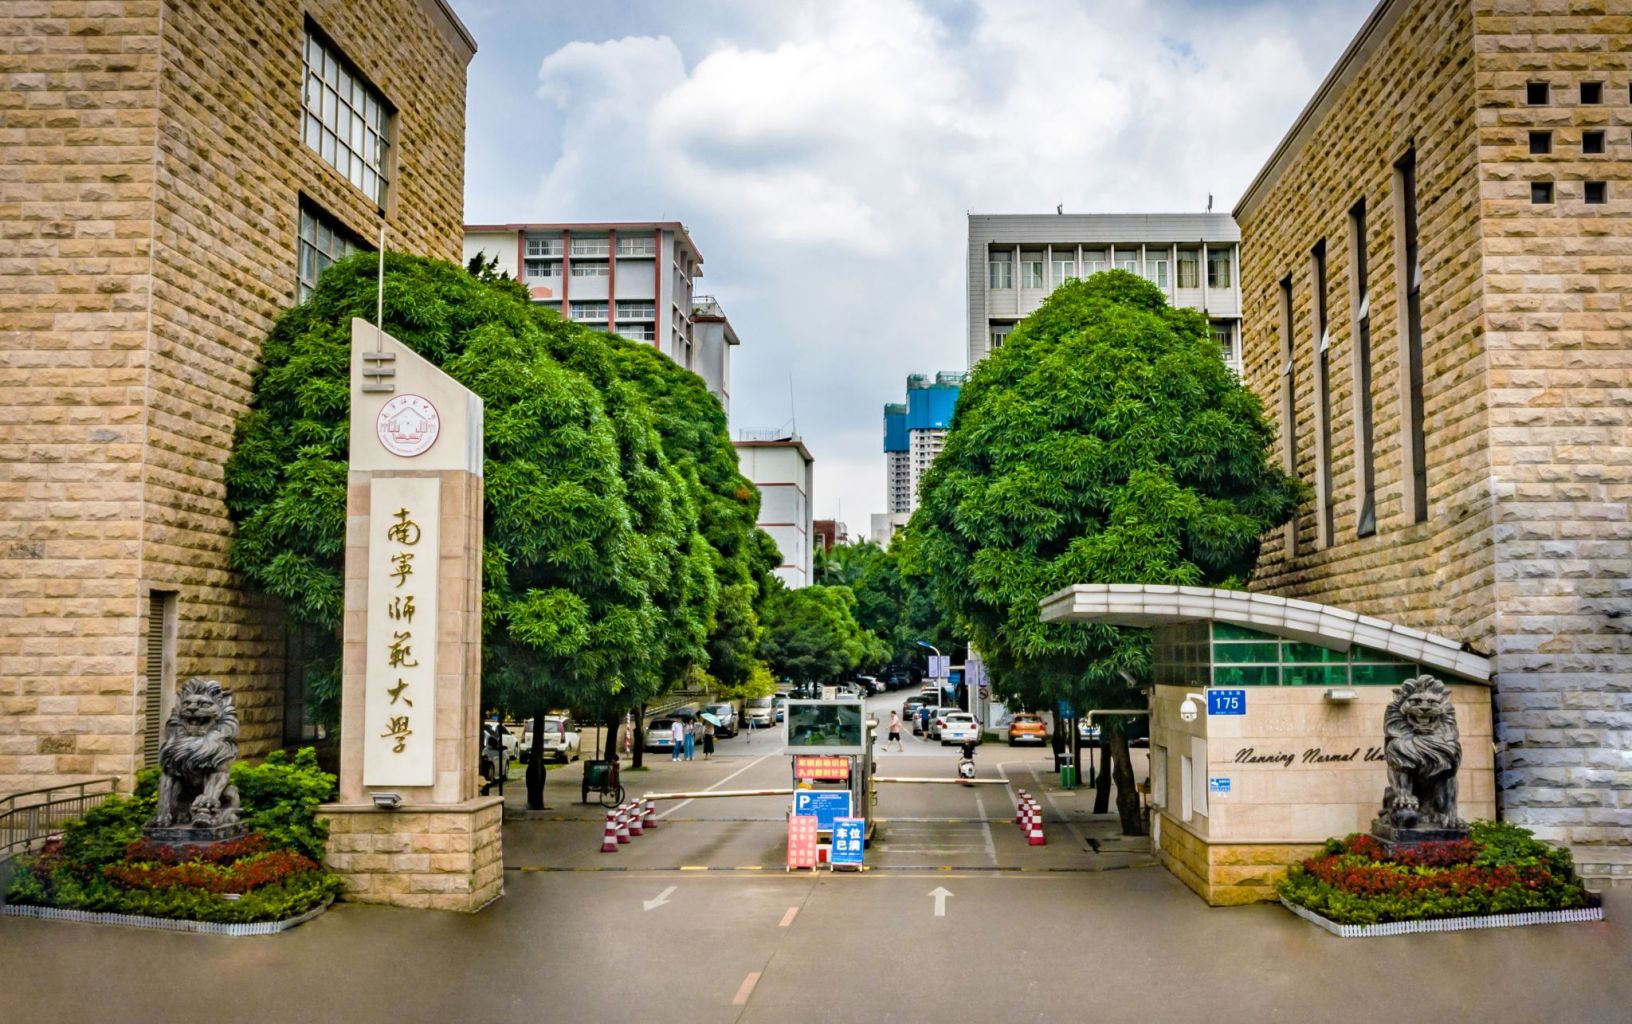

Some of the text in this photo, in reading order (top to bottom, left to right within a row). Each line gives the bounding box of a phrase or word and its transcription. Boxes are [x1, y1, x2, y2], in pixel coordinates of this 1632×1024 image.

[1215, 697, 1239, 709] 175
[1235, 747, 1295, 768] Nanning
[1302, 747, 1361, 764] Normal
[799, 795, 811, 809] P
[836, 827, 861, 840] 车位
[836, 839, 861, 852] 已满
